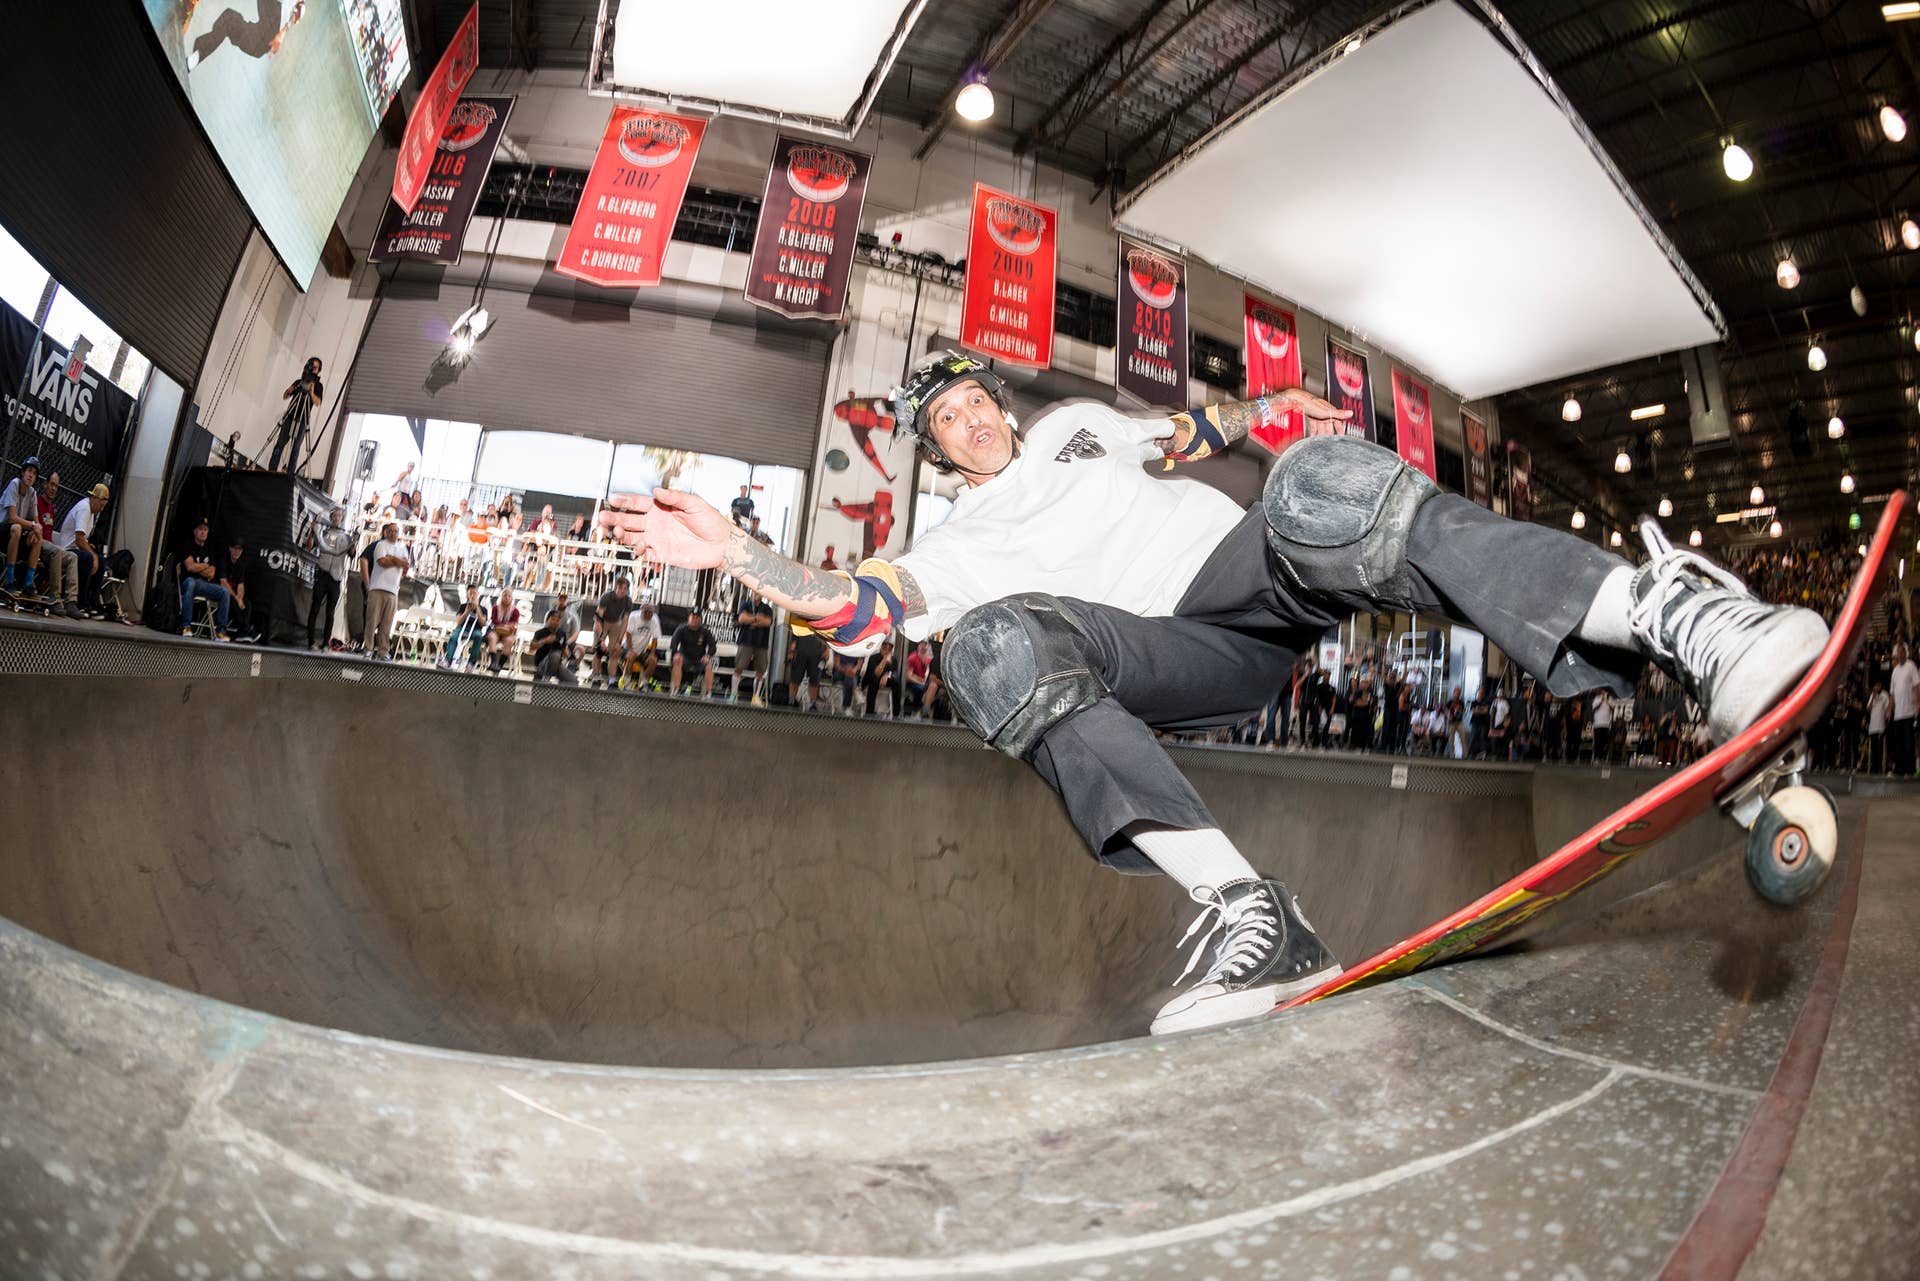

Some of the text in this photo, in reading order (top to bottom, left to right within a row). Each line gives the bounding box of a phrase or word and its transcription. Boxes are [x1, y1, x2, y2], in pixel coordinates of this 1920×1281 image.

[432, 153, 467, 176] 06
[612, 167, 662, 191] 2007
[423, 185, 456, 201] ASSAN
[787, 197, 837, 229] 2008
[387, 237, 443, 256] C.BURNSIDE
[593, 222, 642, 245] C.MILLER
[580, 248, 642, 273] C.BURNSIDE
[778, 256, 825, 280] C.MILLER
[992, 250, 1034, 281] 2009
[774, 281, 819, 306] M.KNOOP
[993, 278, 1029, 305] B.LASEK
[1135, 300, 1171, 337] 2010
[974, 329, 1038, 362] J.KINDSTRAND
[29, 340, 99, 424] VANS
[34, 412, 58, 440] THE
[57, 425, 94, 456] WALL"
[259, 547, 296, 574] "OFF
